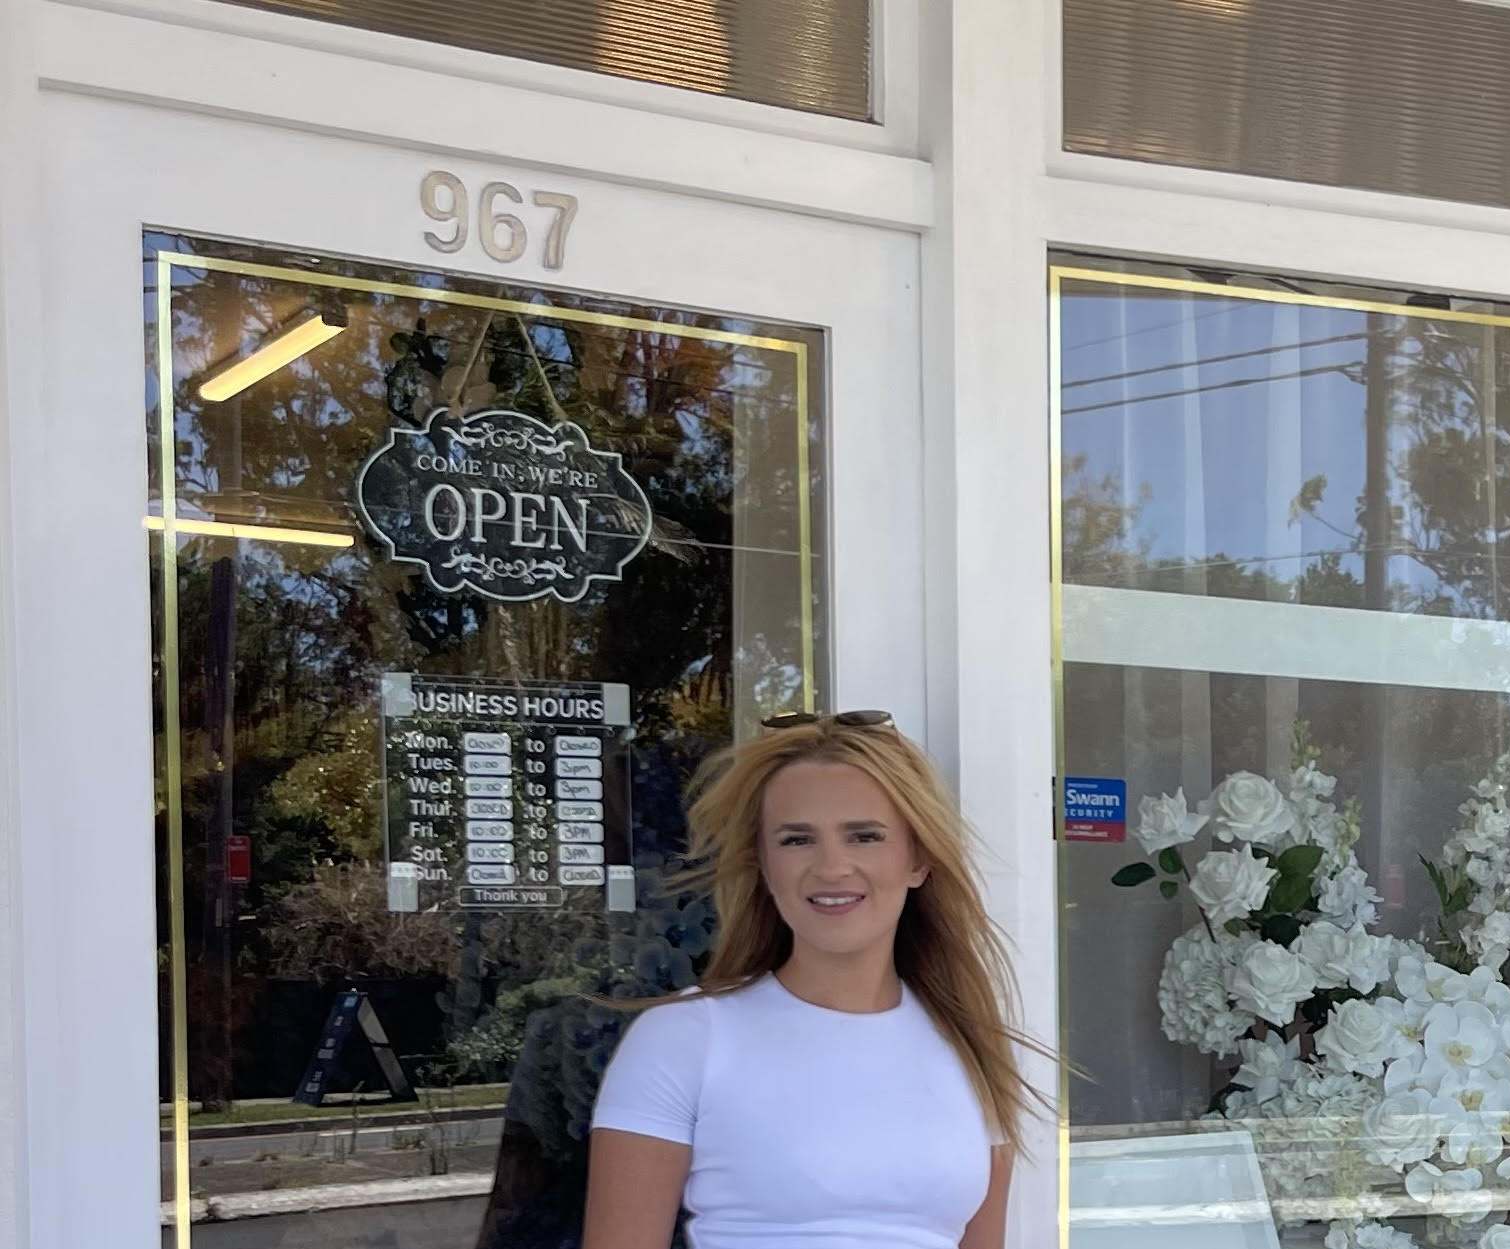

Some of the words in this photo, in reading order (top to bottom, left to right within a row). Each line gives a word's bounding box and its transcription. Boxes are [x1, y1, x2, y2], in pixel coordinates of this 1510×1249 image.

[420, 170, 578, 270] 967
[416, 454, 482, 475] COME
[527, 466, 599, 489] WE'RE
[424, 483, 591, 553] OPEN
[523, 697, 604, 720] HOURS
[406, 733, 454, 750] Mon.
[525, 738, 546, 753] to
[407, 753, 459, 771] Tues.
[525, 759, 546, 774] to
[408, 777, 457, 795] Wed.
[525, 782, 547, 797] to
[1066, 788, 1121, 807] Swann
[410, 799, 458, 817] Thur.
[527, 804, 547, 819] to
[409, 821, 439, 838] Fri.
[528, 823, 548, 840] to
[410, 845, 448, 862] Sat.
[528, 848, 549, 863] to
[414, 864, 453, 881] Sun.
[528, 867, 549, 882] to
[474, 889, 520, 902] Thank
[520, 892, 548, 904] you
